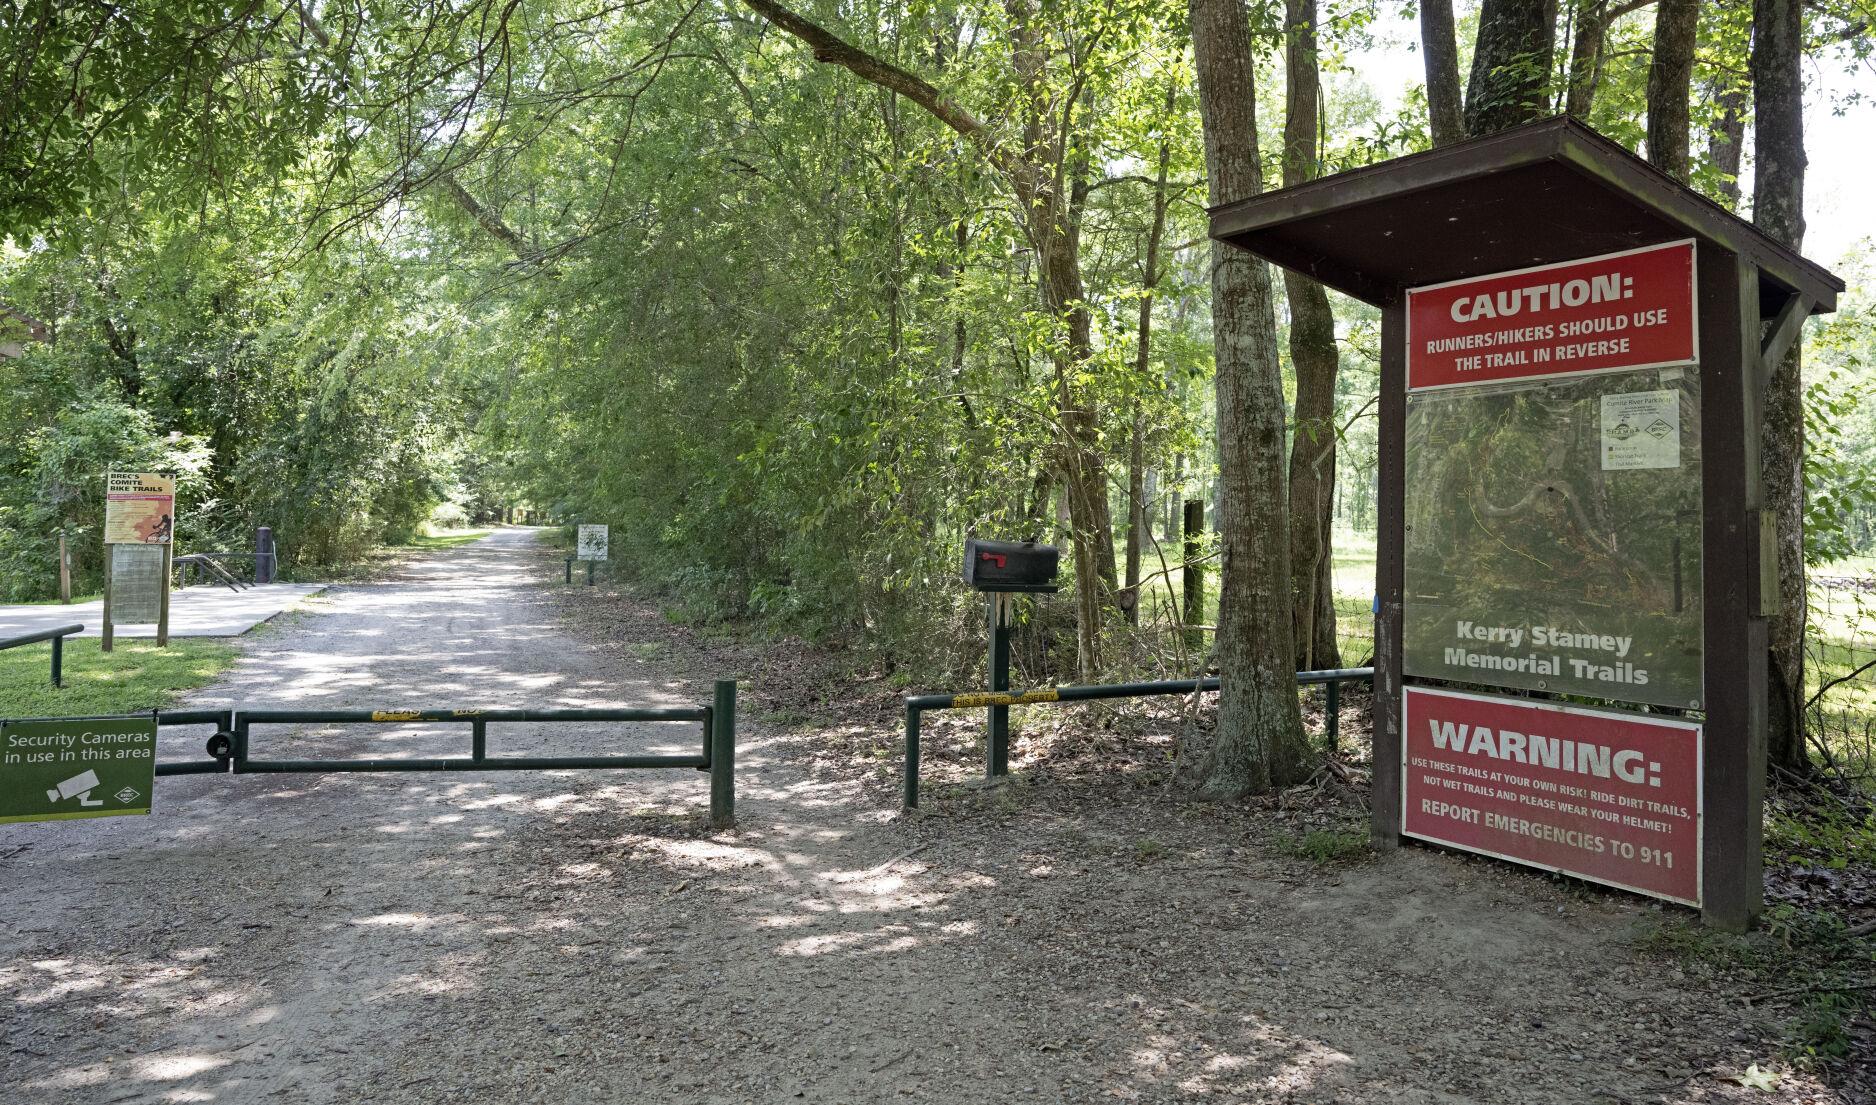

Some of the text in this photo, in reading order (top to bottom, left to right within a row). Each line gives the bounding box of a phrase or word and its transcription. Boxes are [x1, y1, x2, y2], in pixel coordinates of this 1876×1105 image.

[1450, 272, 1633, 323] CAUTION:
[1427, 309, 1667, 354] RUNNERS/HIKERS SHOULD USE
[1455, 338, 1630, 371] THE TRAIL IN REVERSE
[1457, 621, 1632, 657] Kerry Stamey
[1444, 648, 1648, 685] Memorial Trails
[952, 698, 970, 706] THIS
[5, 748, 150, 763] in use in this area
[9, 732, 150, 748] Security Cameras
[1429, 719, 1661, 788] WARNING:
[1412, 757, 1690, 820] USE THESE TRAILS AT YOUR OWN RISK! RIDE DIRT TRAILS,
[1424, 775, 1672, 834] NOT WET TRAILS AND PLEASE WEAR YOUR HELMET!
[1422, 798, 1673, 868] REPORT EMERGENCIES TO 911
